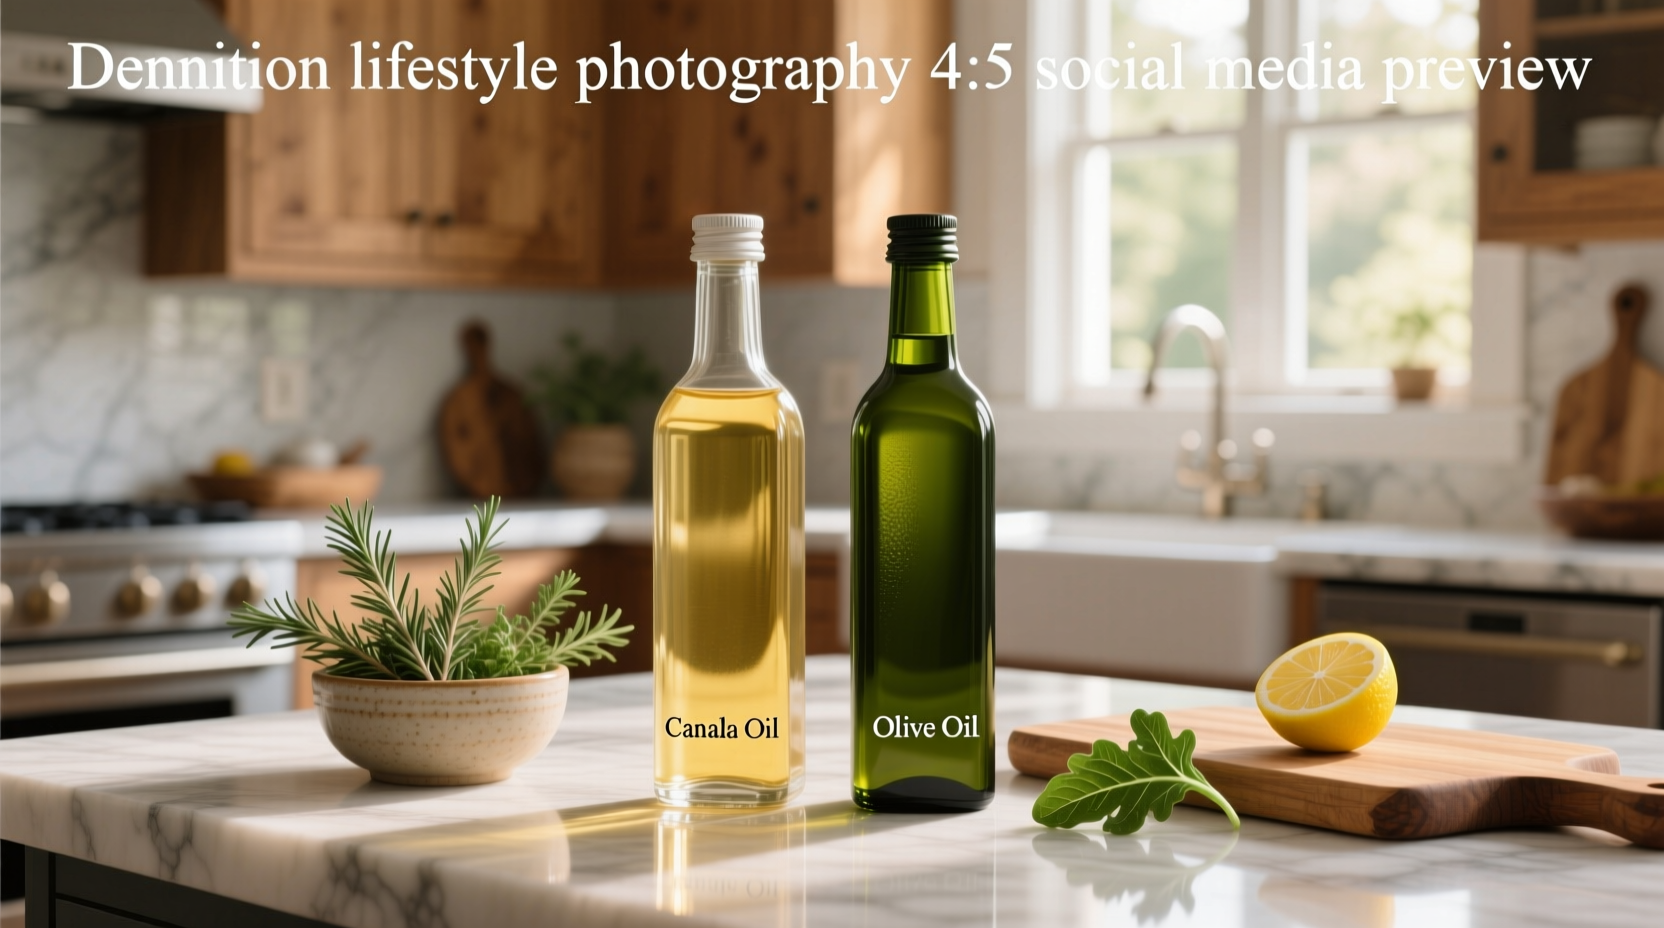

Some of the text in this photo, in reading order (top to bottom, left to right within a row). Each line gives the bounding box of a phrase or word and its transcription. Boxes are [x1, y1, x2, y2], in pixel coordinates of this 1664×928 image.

[665, 716, 779, 739] Canala Oil
[872, 715, 980, 738] Olive Oil
